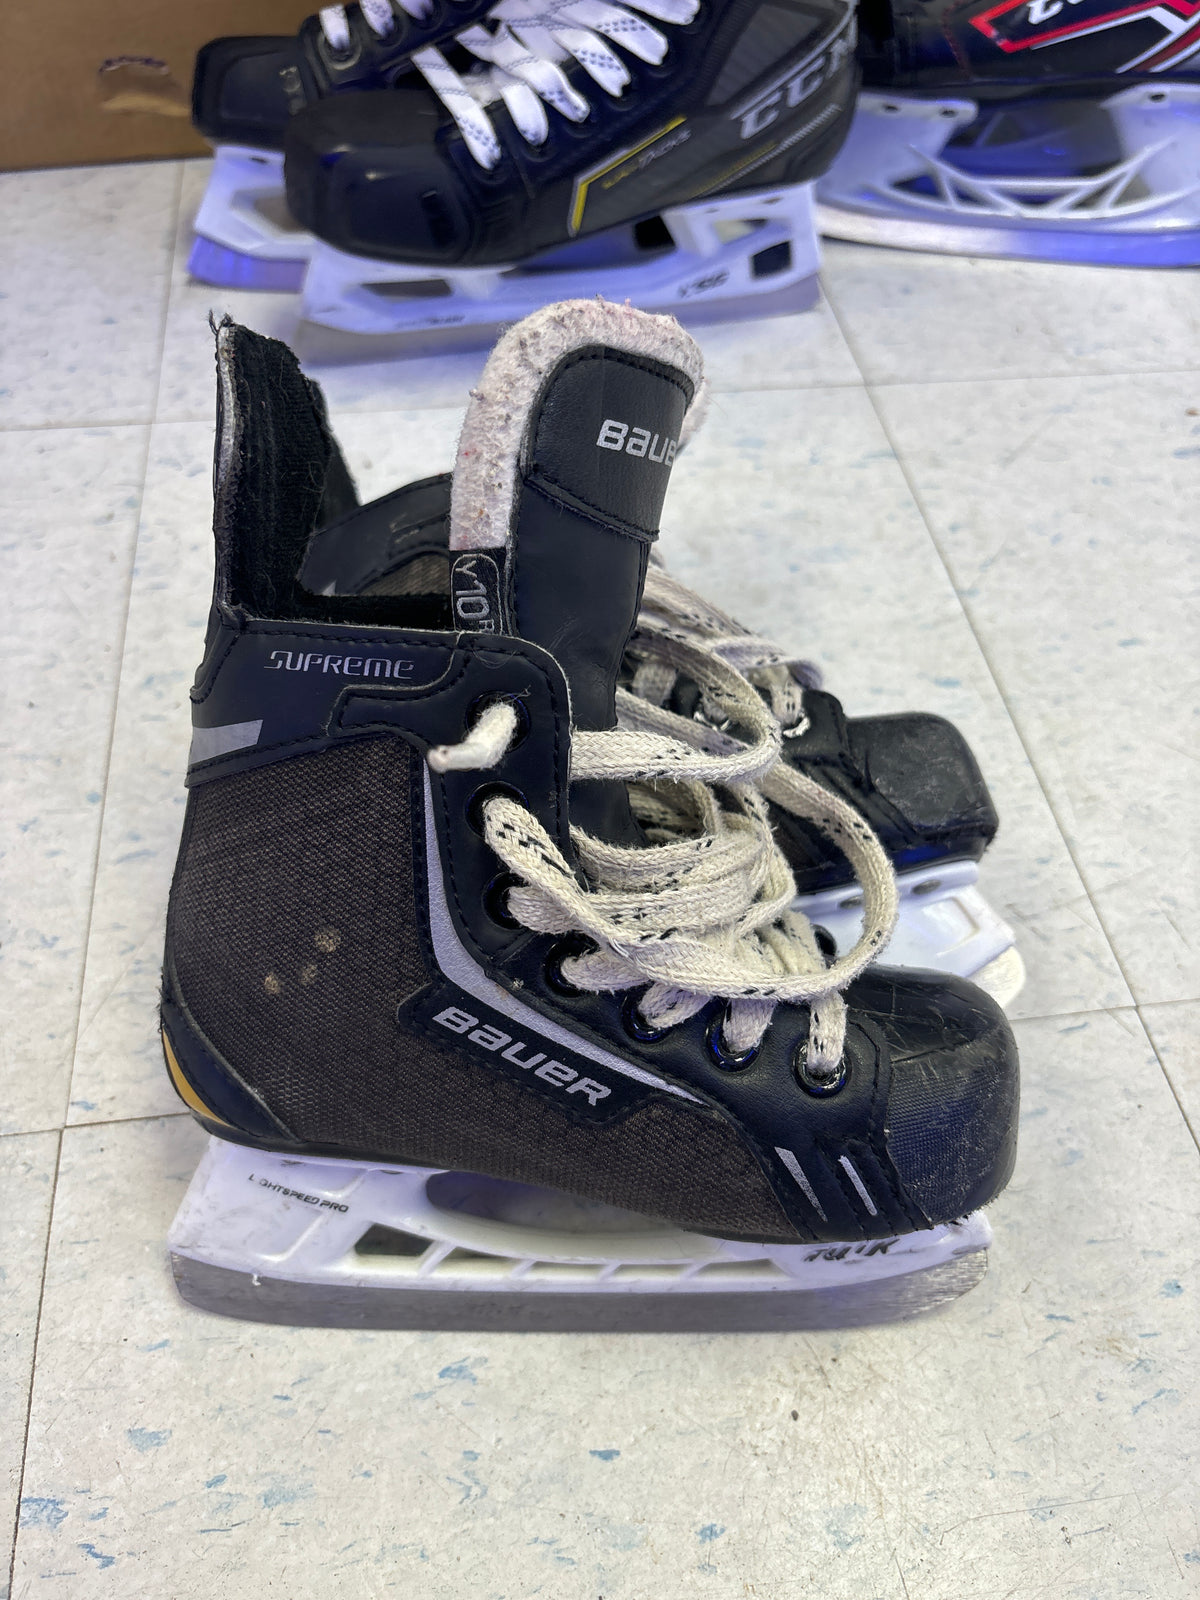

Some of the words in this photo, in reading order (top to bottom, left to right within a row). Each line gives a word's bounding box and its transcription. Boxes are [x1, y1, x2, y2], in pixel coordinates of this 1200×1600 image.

[596, 419, 677, 467] BAUE
[264, 650, 414, 680] SUPREME
[432, 1006, 612, 1107] BAUER
[248, 1173, 321, 1205] LGHTSPEED
[319, 1199, 350, 1213] PRO
